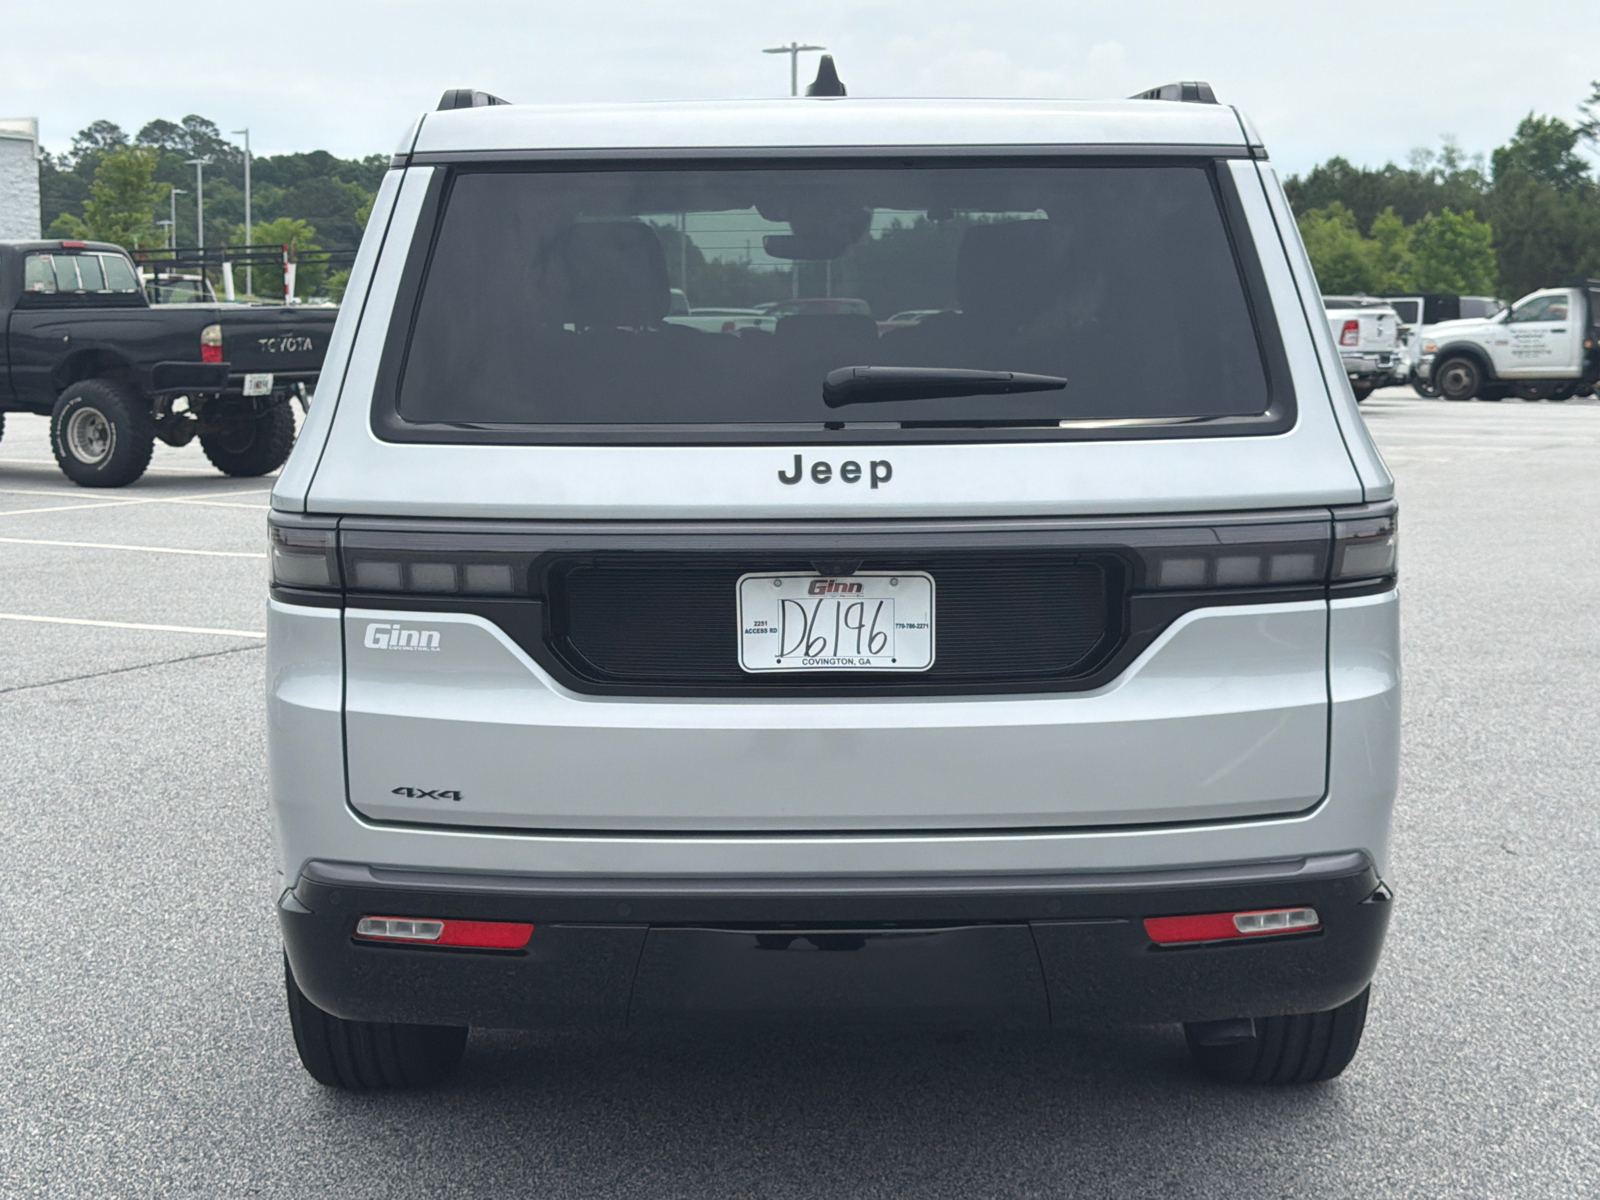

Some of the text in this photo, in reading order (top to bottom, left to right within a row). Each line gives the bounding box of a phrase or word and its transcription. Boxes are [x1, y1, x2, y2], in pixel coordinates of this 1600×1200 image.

[258, 337, 313, 353] TOYOTA
[777, 454, 893, 489] Jeep
[808, 579, 863, 595] Ginn
[364, 623, 441, 649] Ginn
[775, 598, 888, 658] D6196
[802, 658, 871, 666] COVINGTON, GA
